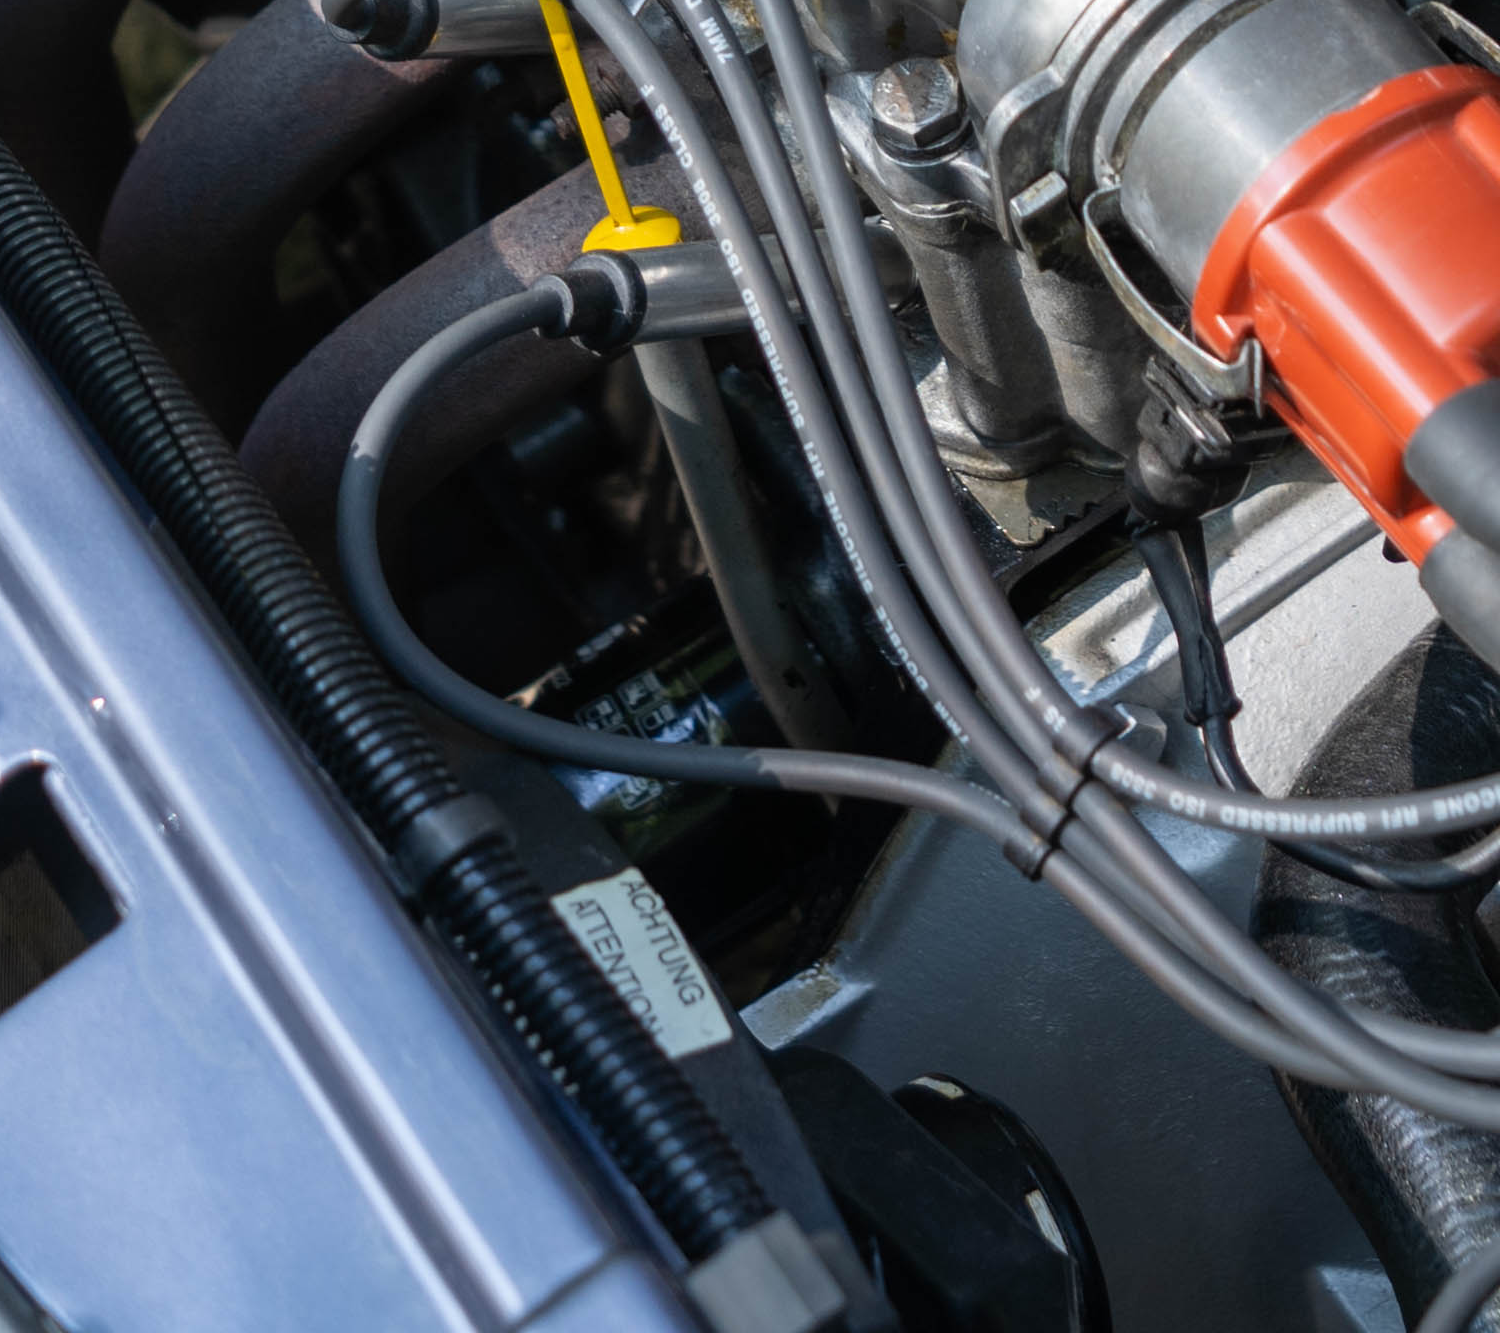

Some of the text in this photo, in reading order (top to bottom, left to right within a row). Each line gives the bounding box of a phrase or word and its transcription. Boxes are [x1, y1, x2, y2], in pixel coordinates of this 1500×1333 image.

[700, 16, 735, 64] 7MM
[640, 83, 656, 98] F
[654, 103, 694, 168] CLASS
[720, 238, 743, 277] ISO
[742, 287, 806, 431] SUPPRESSED
[803, 441, 825, 480] RFI
[824, 490, 875, 594] SILICONE
[875, 605, 930, 692] DOUBLE
[1168, 792, 1206, 819] ISO
[1219, 805, 1367, 834] SUPPRESSED
[1381, 804, 1419, 830] RFI
[621, 877, 707, 1008] ACHTUNG
